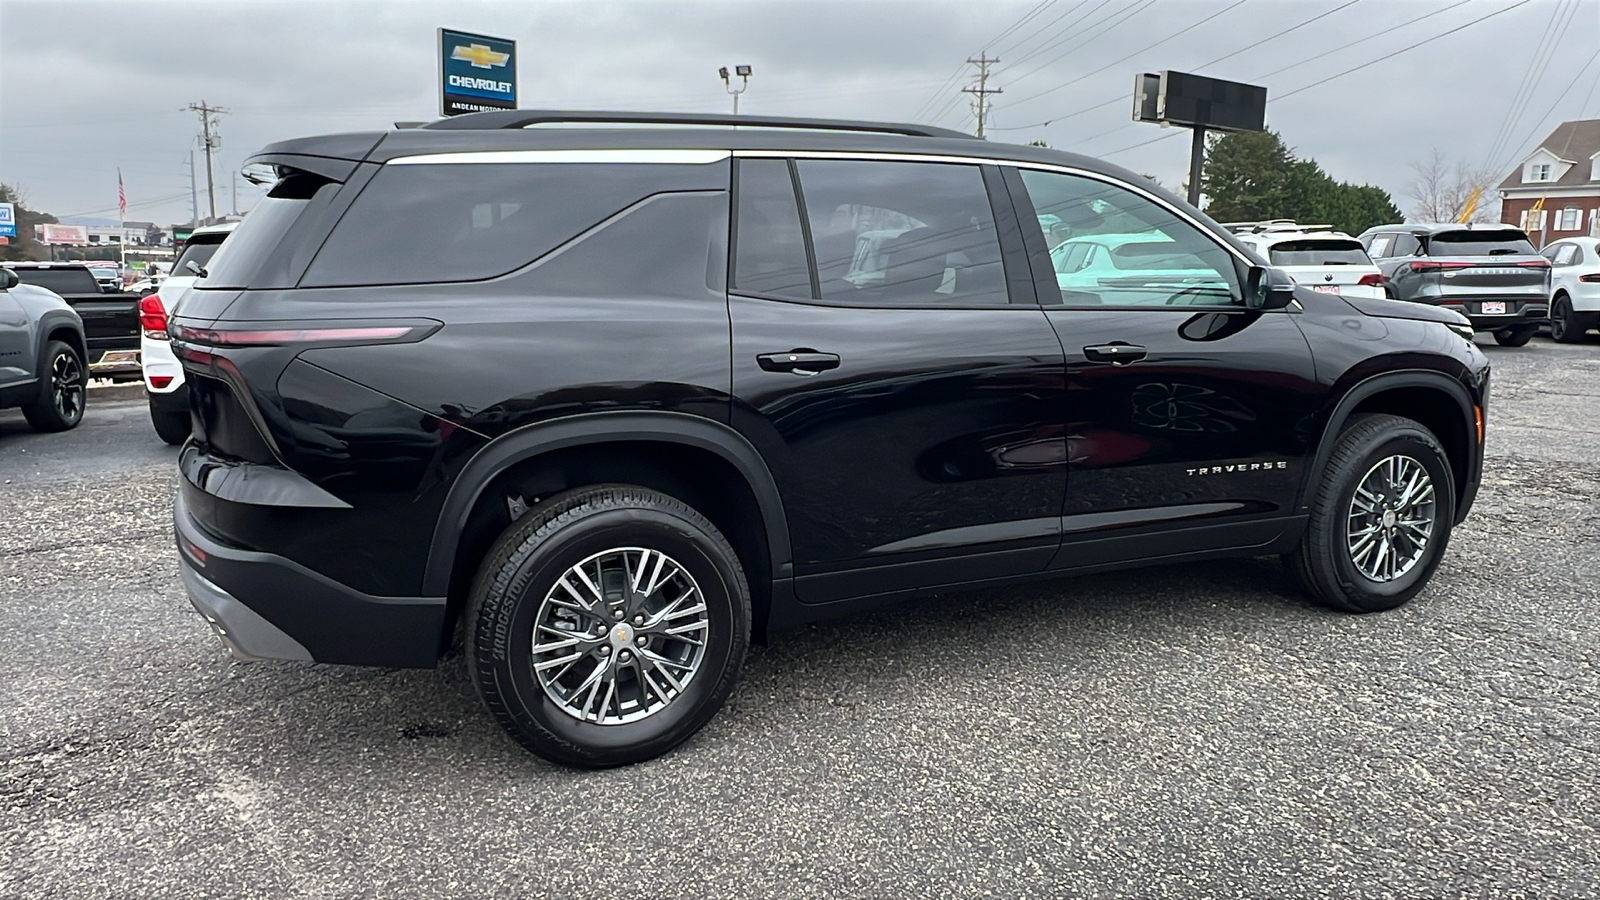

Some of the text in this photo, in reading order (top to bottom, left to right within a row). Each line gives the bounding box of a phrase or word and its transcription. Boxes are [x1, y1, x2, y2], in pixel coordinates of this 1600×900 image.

[449, 75, 512, 93] CHEVROLET
[452, 102, 478, 112] ANDEAN
[1186, 461, 1287, 476] TRAVERSE
